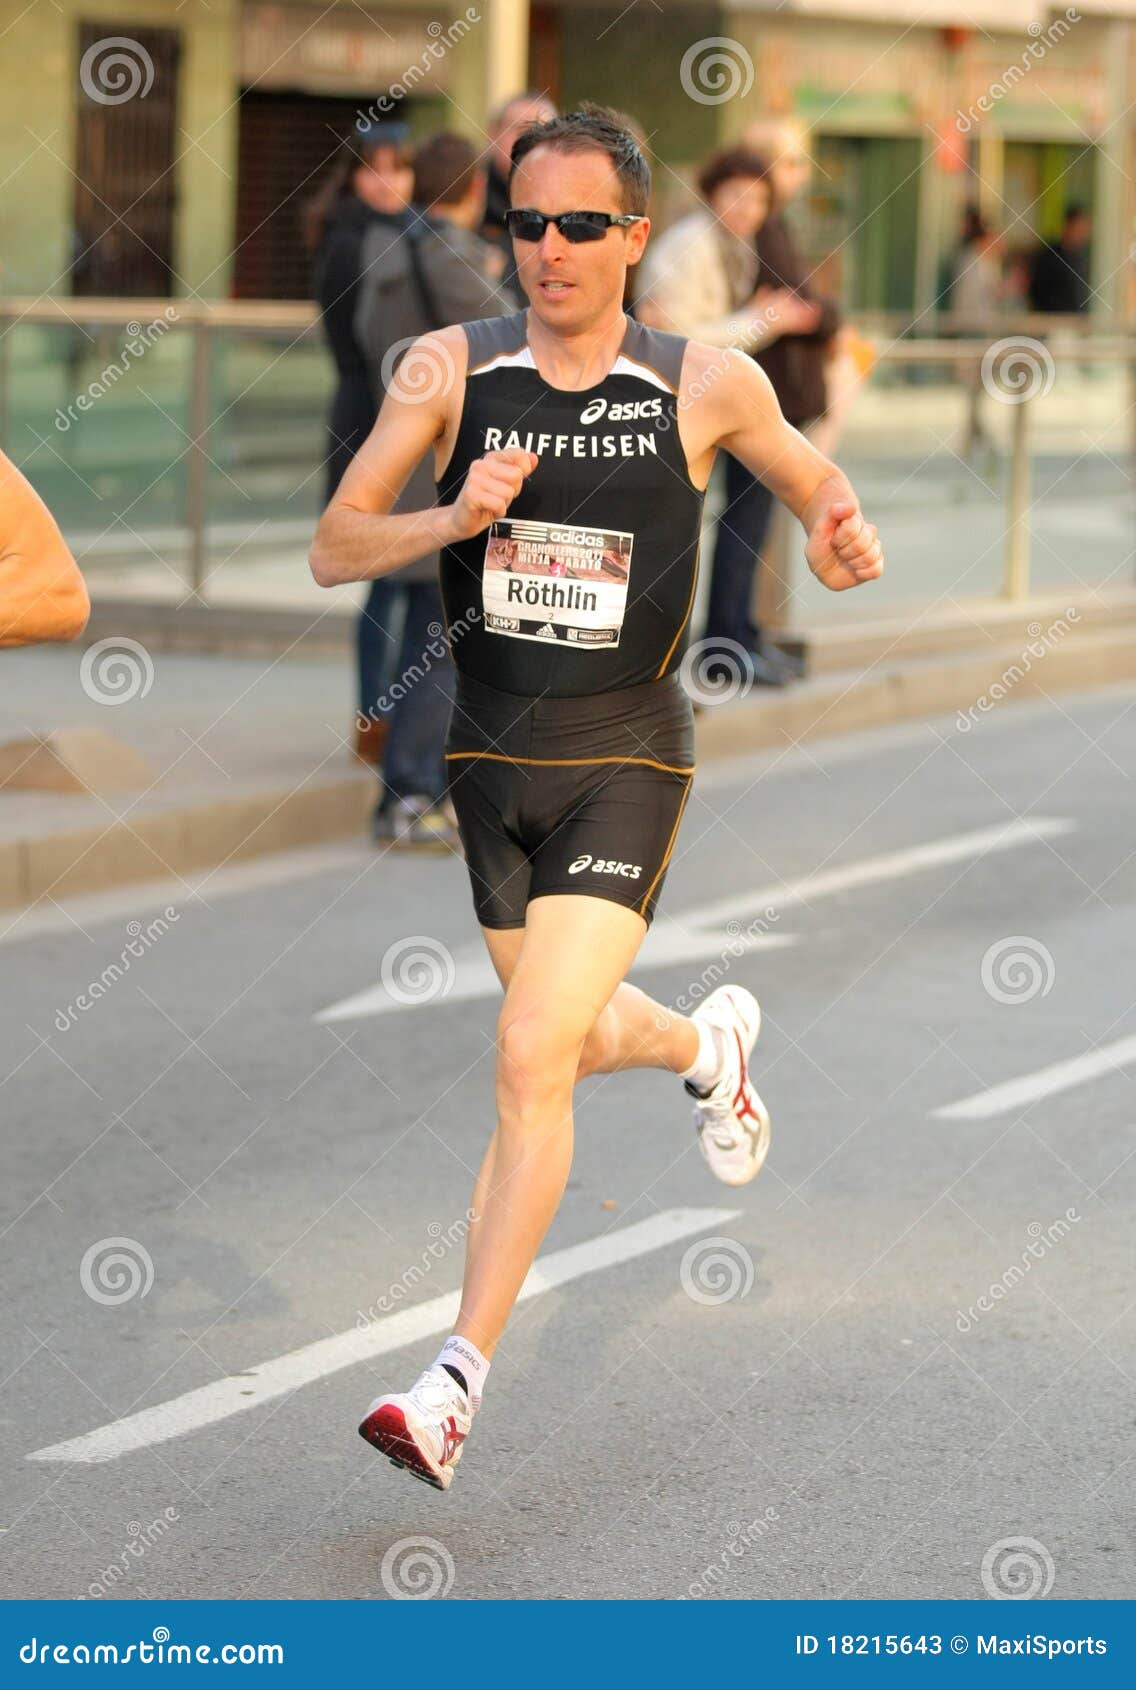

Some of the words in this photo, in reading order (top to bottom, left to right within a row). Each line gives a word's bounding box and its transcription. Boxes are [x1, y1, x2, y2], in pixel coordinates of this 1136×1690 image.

[608, 398, 662, 421] asics
[484, 427, 658, 458] RAIFFEISEN
[549, 530, 604, 548] adidas
[507, 578, 597, 611] Röthlin
[591, 859, 643, 879] asics
[455, 1343, 481, 1370] asics
